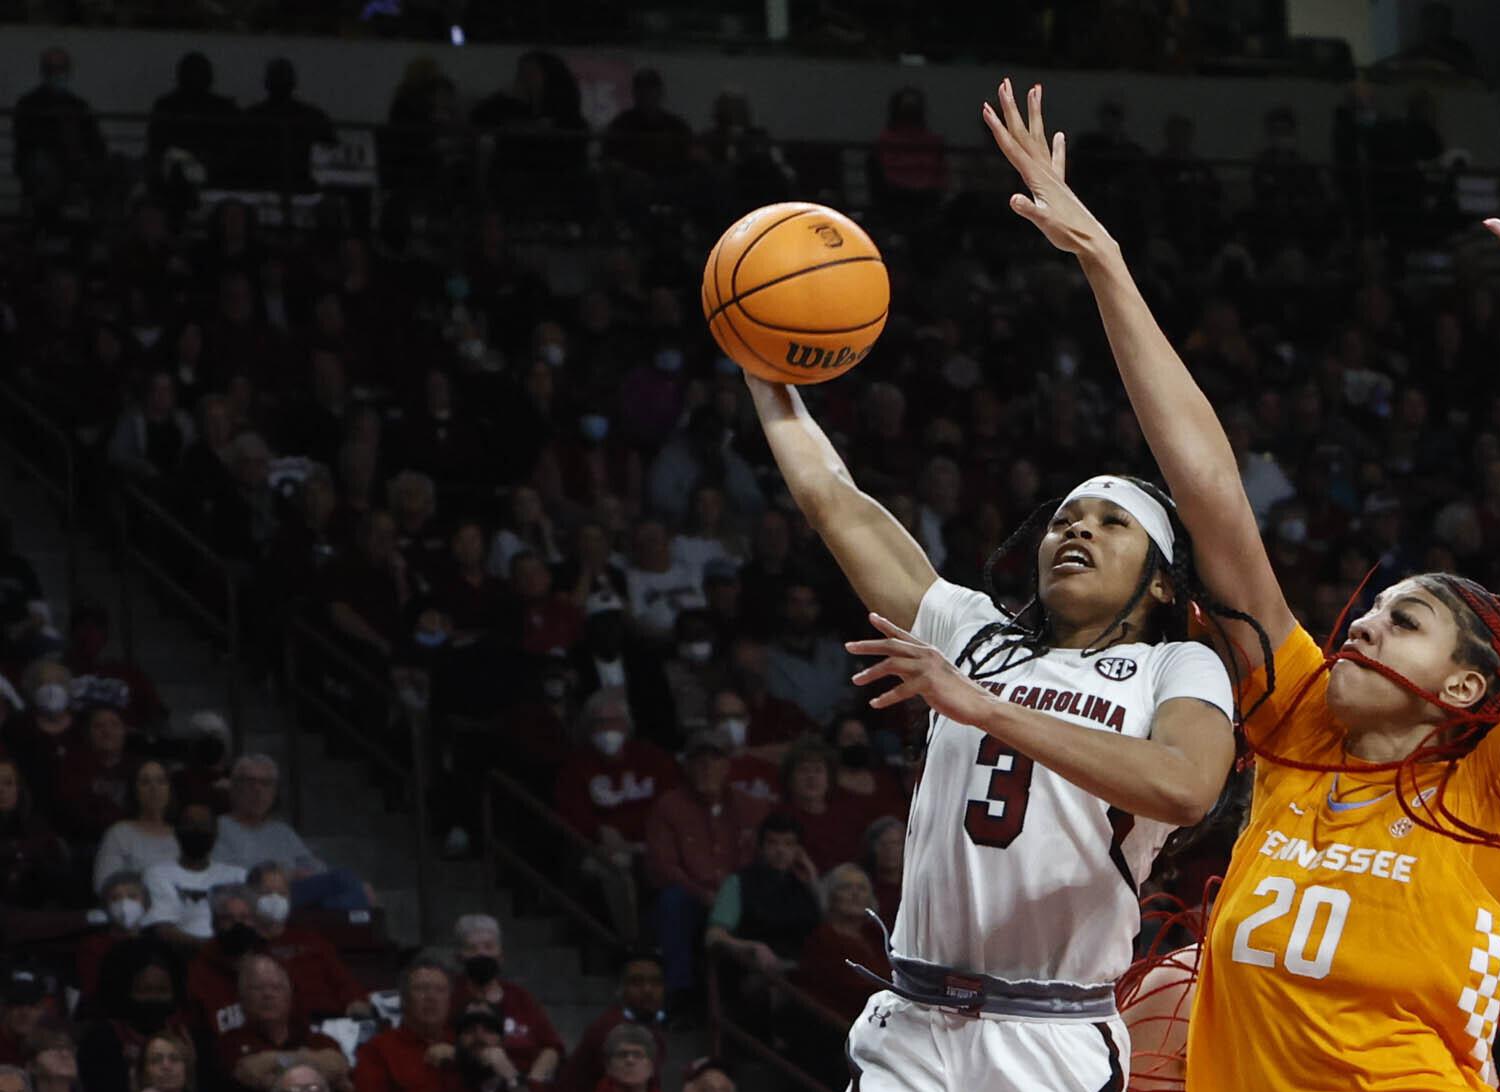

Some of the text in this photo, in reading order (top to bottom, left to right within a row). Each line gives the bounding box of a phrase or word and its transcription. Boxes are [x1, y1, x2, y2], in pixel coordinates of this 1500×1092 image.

[1097, 658, 1136, 679] SEC
[1009, 685, 1127, 733] CAROLINA
[964, 732, 1035, 849] 3
[1260, 830, 1418, 884] ENNSSEE
[1232, 876, 1351, 979] 20
